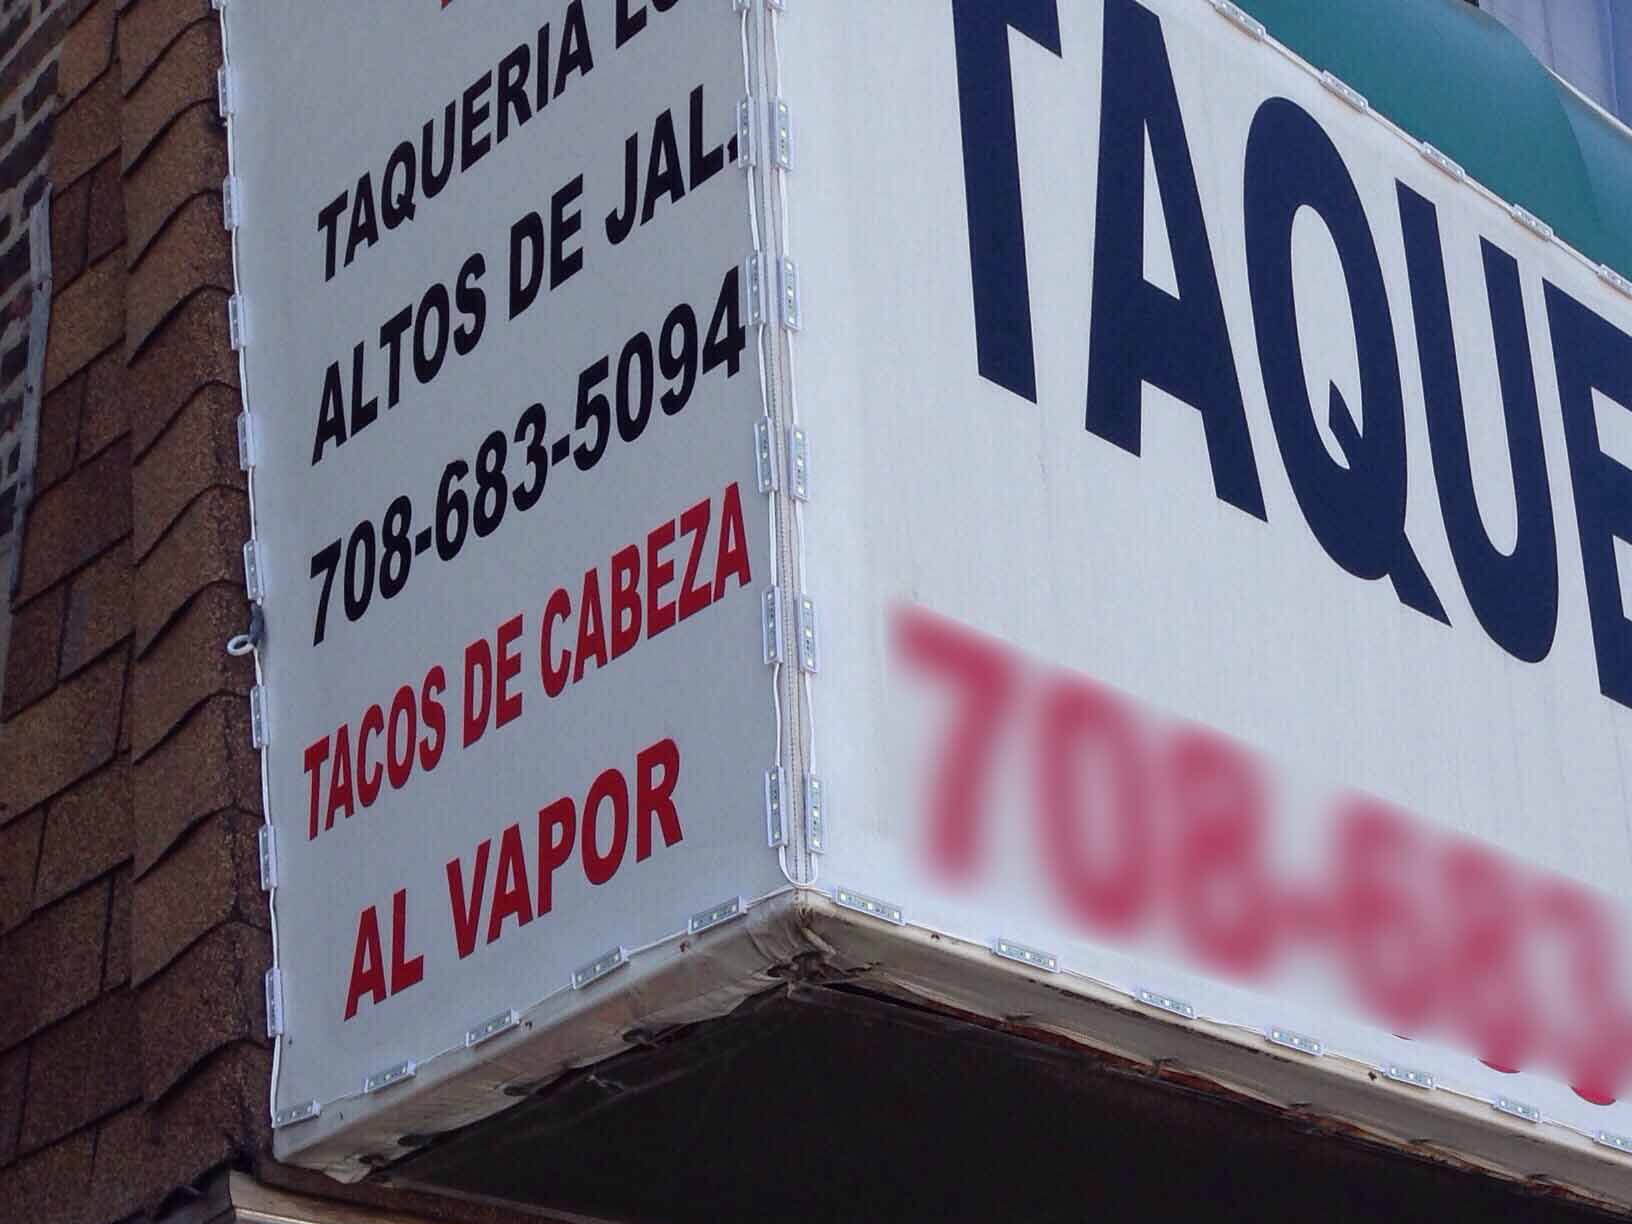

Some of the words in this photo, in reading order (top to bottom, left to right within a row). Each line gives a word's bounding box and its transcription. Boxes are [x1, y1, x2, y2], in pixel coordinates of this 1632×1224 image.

[311, 252, 487, 467] ALTOS
[509, 173, 583, 320] DE
[605, 84, 739, 245] JAL.
[316, 0, 594, 283] TAQUERIA
[310, 265, 747, 646] 708-683-5094
[304, 665, 445, 841] TACOS
[463, 613, 523, 749] DE
[540, 481, 751, 699] CABEZA
[343, 887, 424, 1021] AL
[445, 737, 684, 960] VAPOR
